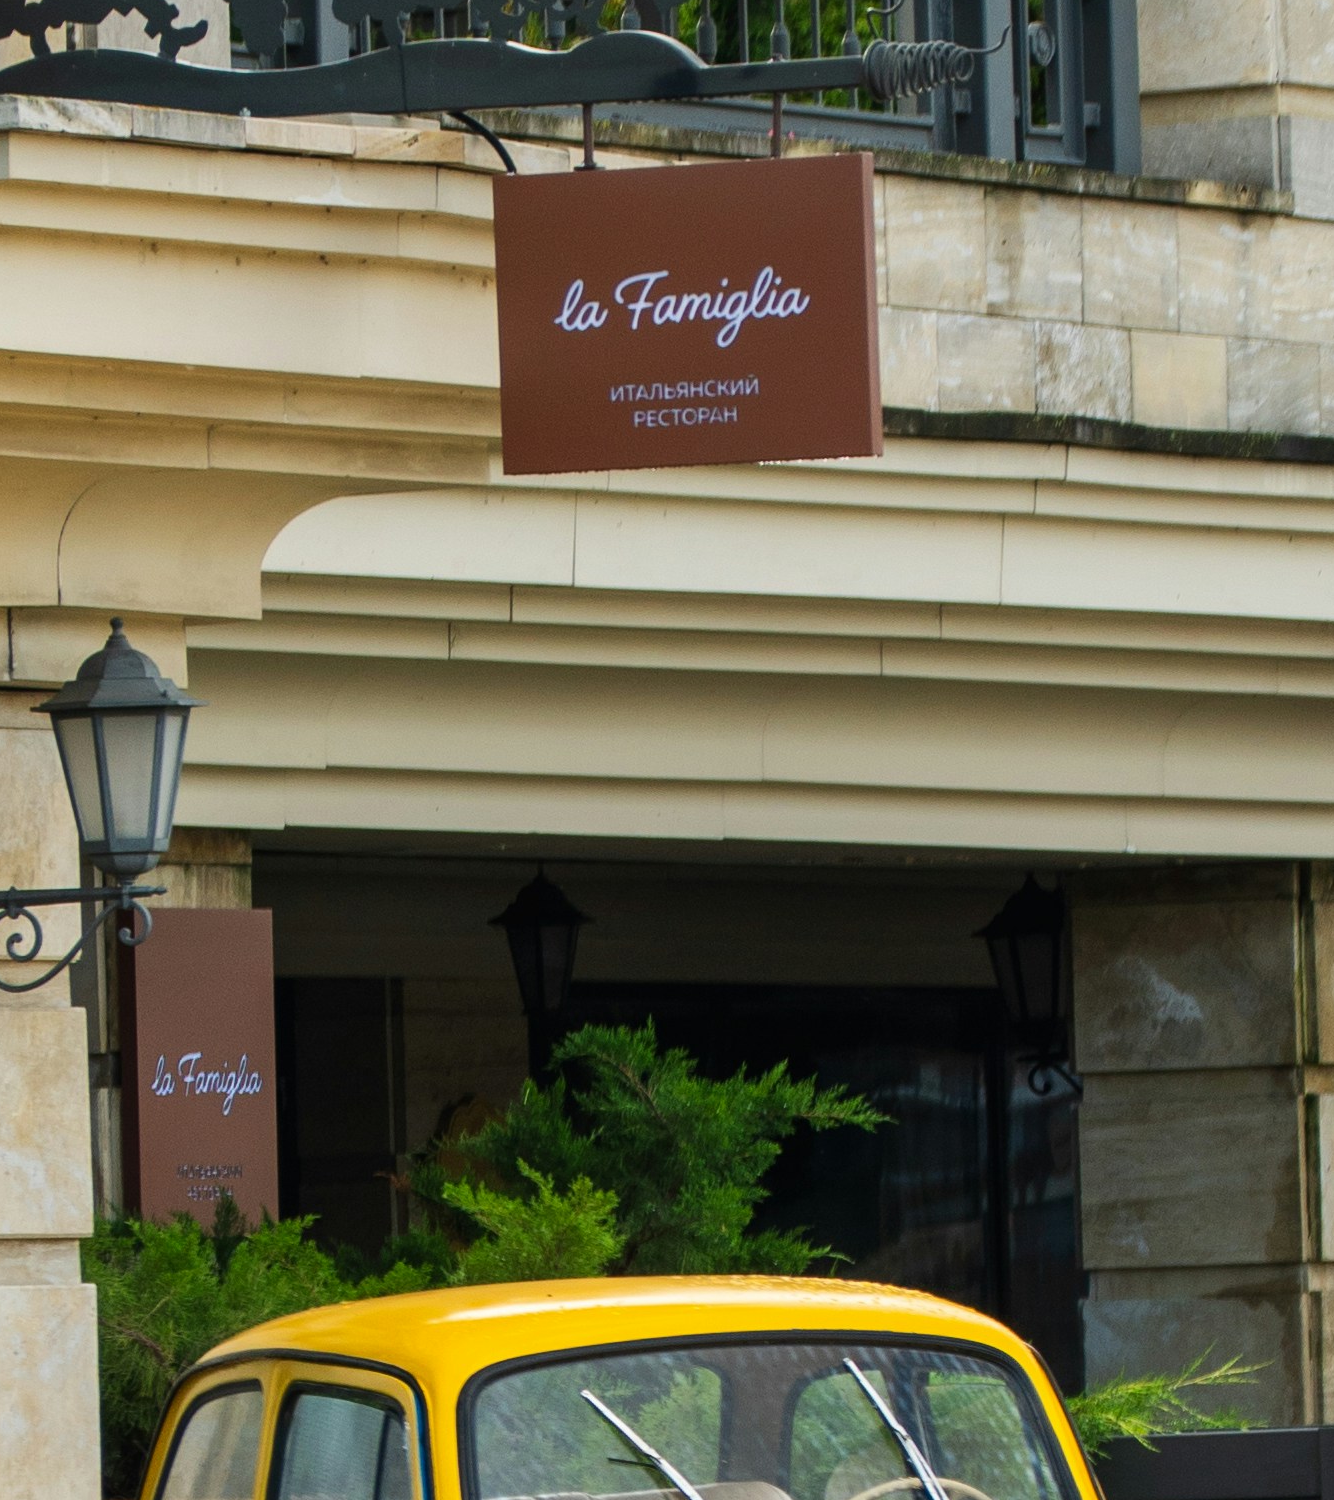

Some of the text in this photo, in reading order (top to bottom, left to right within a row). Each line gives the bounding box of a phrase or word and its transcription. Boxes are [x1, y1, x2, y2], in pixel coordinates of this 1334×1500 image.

[553, 265, 811, 348] la Famiglia
[609, 374, 760, 402] ИТАЛЬЯНСКИЙ
[633, 406, 738, 428] РЕСТОРАН
[151, 1051, 263, 1116] la Famiglia
